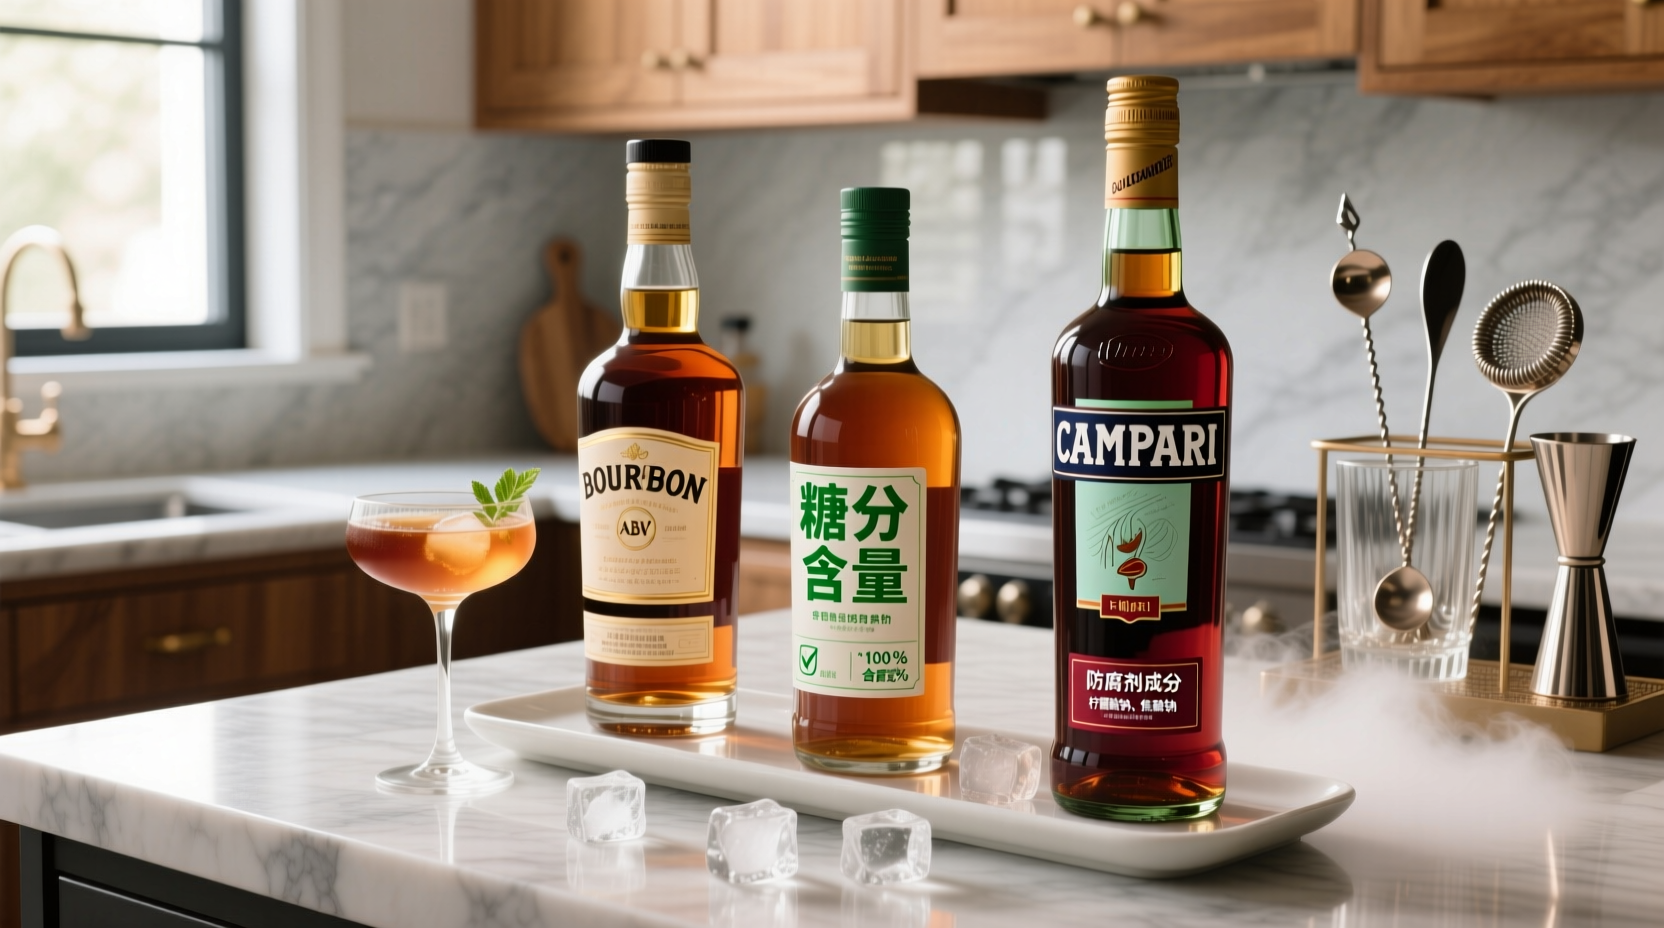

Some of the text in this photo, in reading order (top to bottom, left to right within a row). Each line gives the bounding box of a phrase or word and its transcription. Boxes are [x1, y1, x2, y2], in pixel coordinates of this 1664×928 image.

[1056, 420, 1218, 467] CAMPARI
[619, 520, 652, 536] ABV
[800, 481, 909, 542] 糖分
[802, 544, 908, 604] 含量
[1086, 669, 1182, 693] 防腐剂成分
